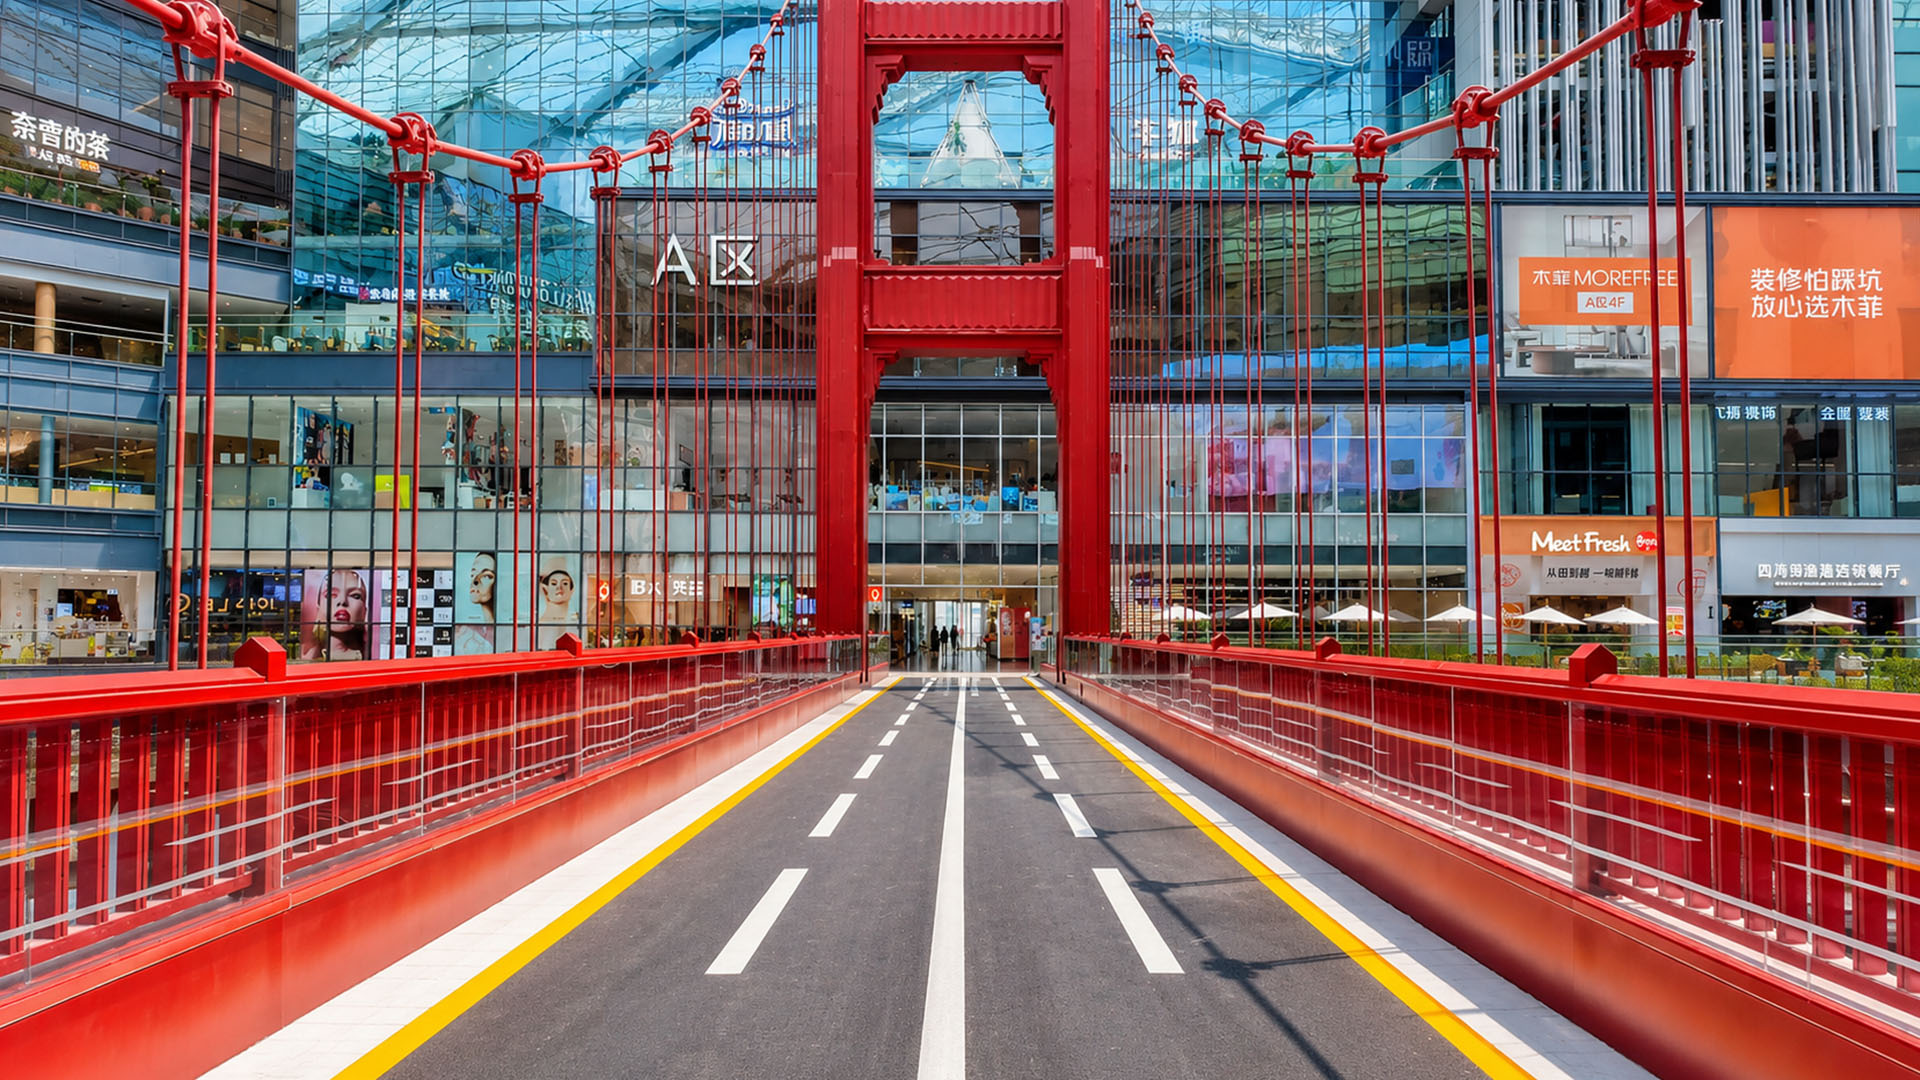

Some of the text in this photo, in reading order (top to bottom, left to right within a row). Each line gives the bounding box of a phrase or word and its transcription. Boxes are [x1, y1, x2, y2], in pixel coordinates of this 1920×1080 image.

[1532, 270, 1570, 285] 木菲
[1750, 267, 1883, 292] 装修怕踩坑
[1751, 294, 1883, 319] 放心选木菲
[1531, 530, 1581, 552] Meet
[1584, 531, 1631, 552] Fresh
